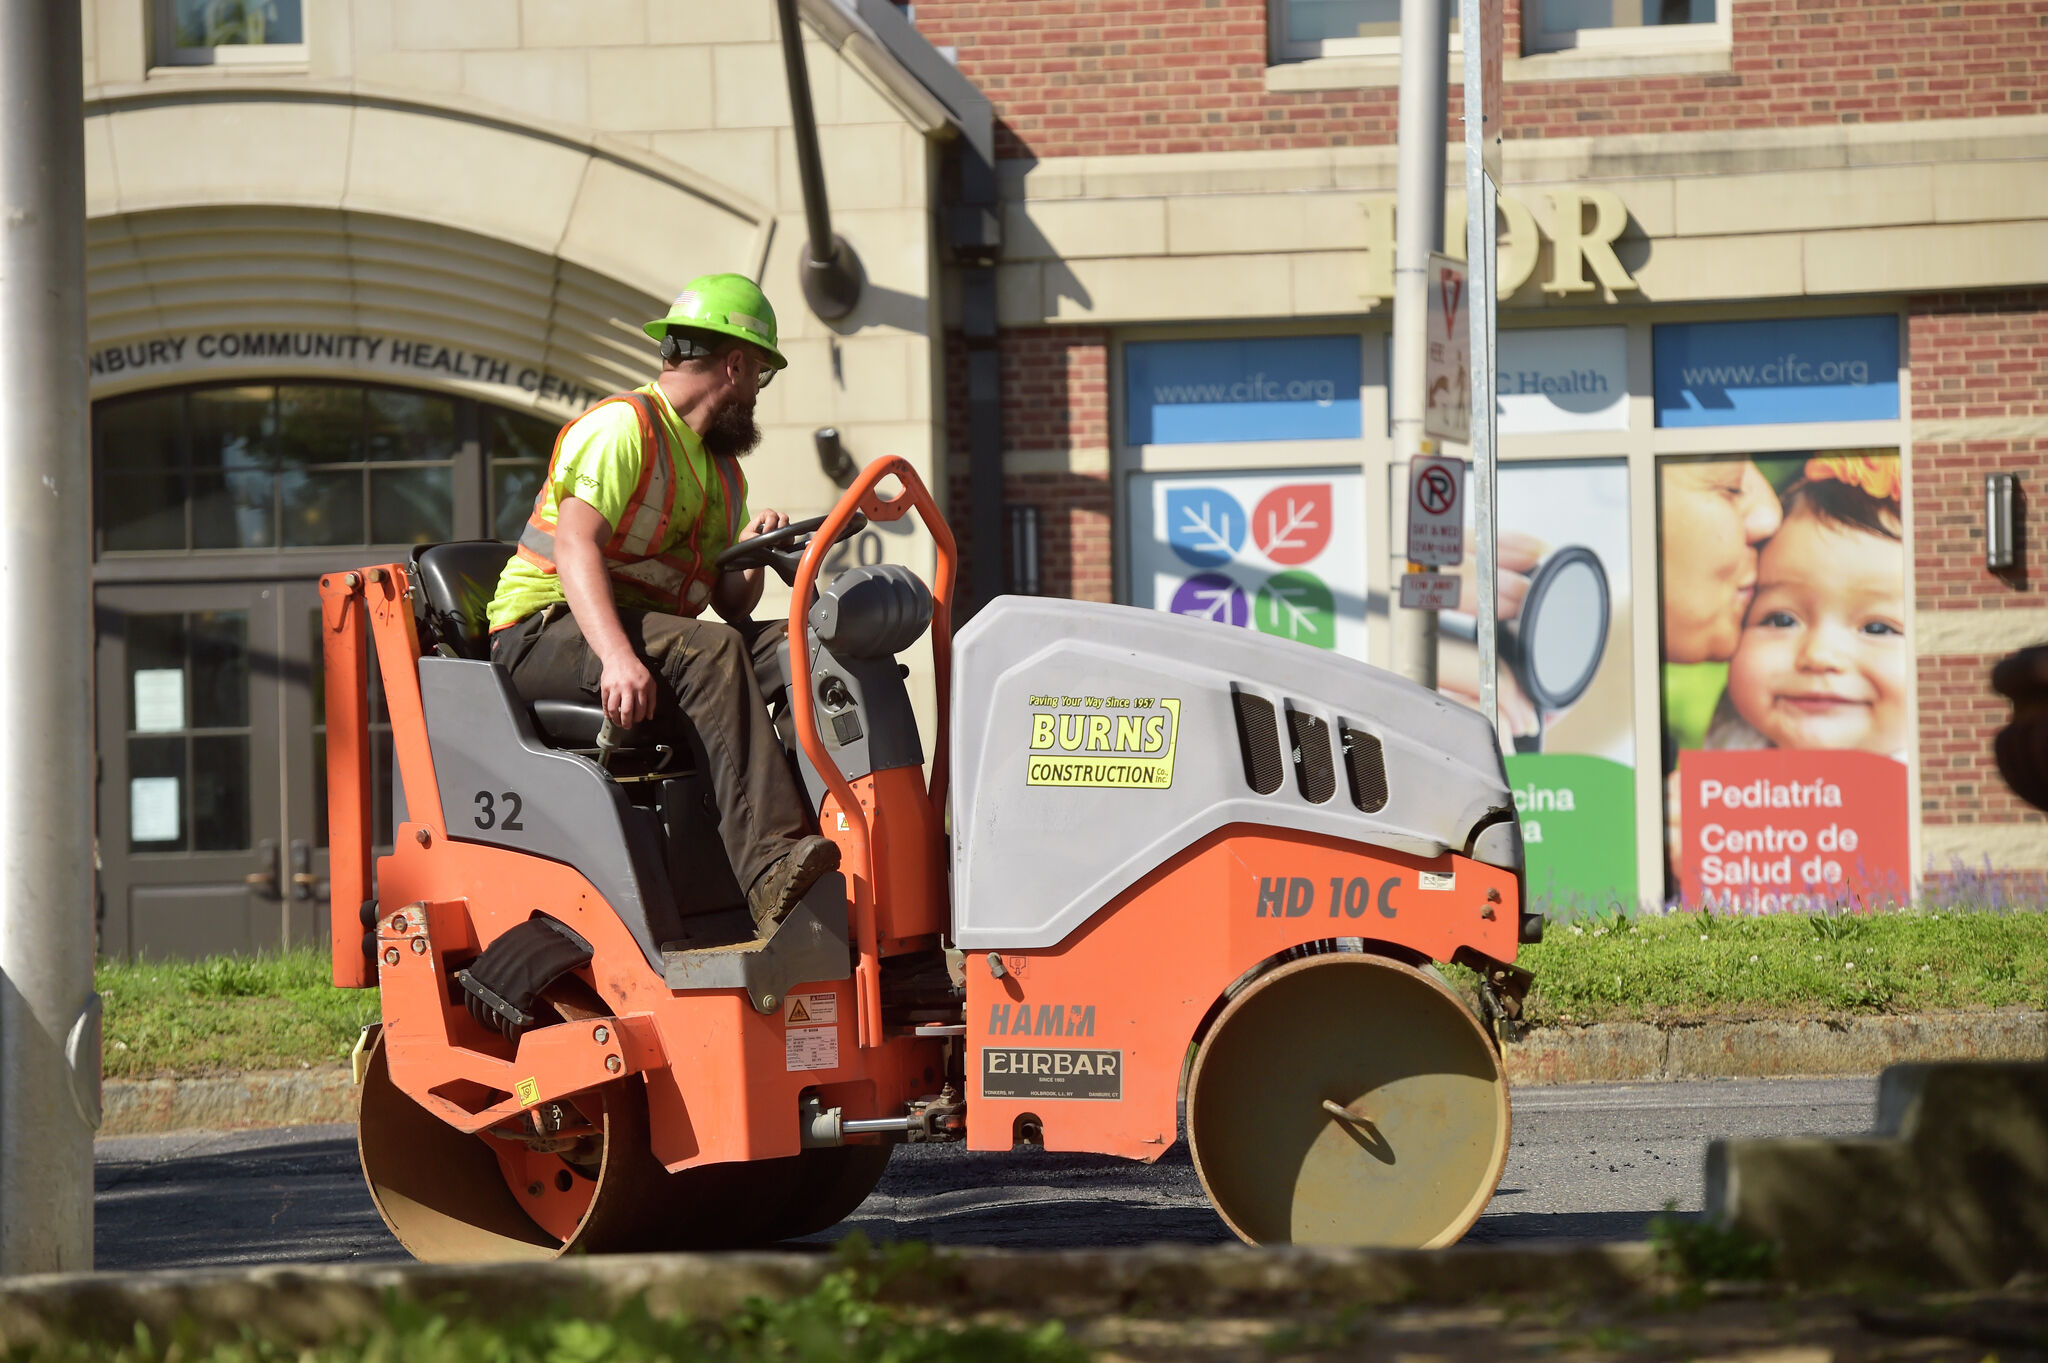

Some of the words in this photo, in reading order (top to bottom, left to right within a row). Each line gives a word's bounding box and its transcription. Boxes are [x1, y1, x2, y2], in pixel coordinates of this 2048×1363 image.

[197, 334, 382, 361] COMMUNITY
[390, 341, 510, 384] HEALTH
[518, 368, 604, 410] CENT
[1518, 369, 1607, 395] Health
[1682, 354, 1868, 387] www.cifc.org
[1154, 372, 1334, 407] www.cifc.org
[824, 531, 883, 574] 20
[1029, 695, 1058, 708] Paving
[1061, 695, 1082, 707] Your
[1084, 696, 1103, 709] Way
[1106, 697, 1130, 708] Since
[1133, 698, 1155, 709] 1957
[1029, 713, 1165, 753] BURNS
[1031, 763, 1155, 784] CONSTRUCTION
[1700, 777, 1842, 808] Pediatría
[474, 790, 523, 831] 32
[1700, 823, 1807, 853] Centro
[1817, 823, 1858, 853] de
[1700, 855, 1791, 885] Salud
[1801, 855, 1842, 884] de
[1256, 877, 1314, 918] HD
[1329, 877, 1370, 918] 10
[1377, 877, 1401, 918] C
[988, 1004, 1096, 1037] HAMM
[988, 1052, 1117, 1076] EHRBAR
